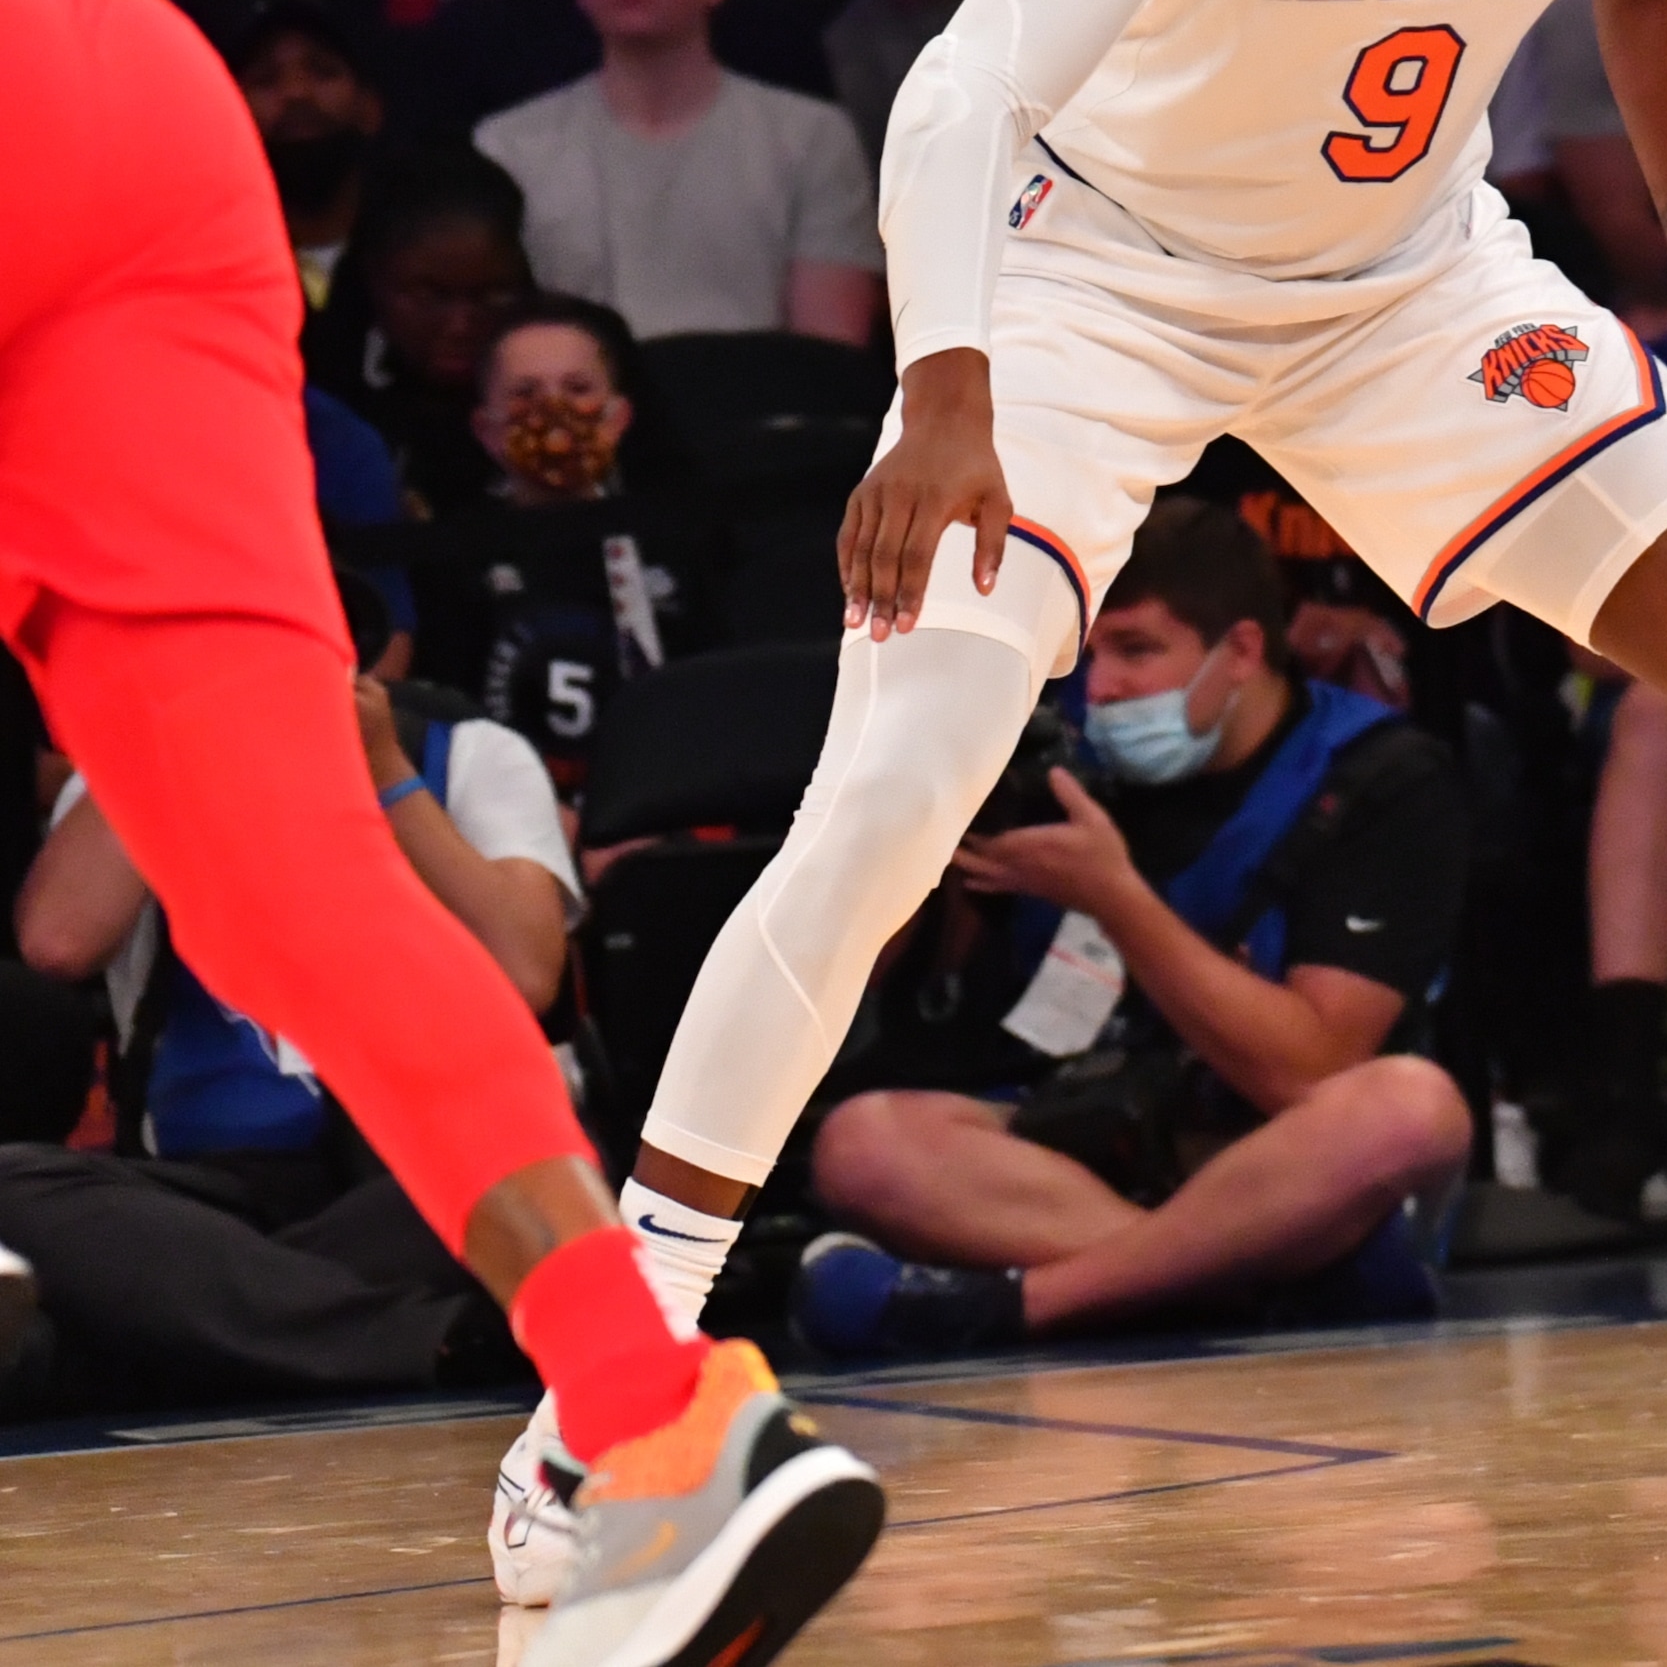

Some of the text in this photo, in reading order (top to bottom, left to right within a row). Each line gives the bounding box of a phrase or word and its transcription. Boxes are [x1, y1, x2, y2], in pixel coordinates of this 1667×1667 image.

[1321, 24, 1466, 183] 9
[1481, 324, 1589, 401] KNICKS
[546, 658, 595, 739] 5
